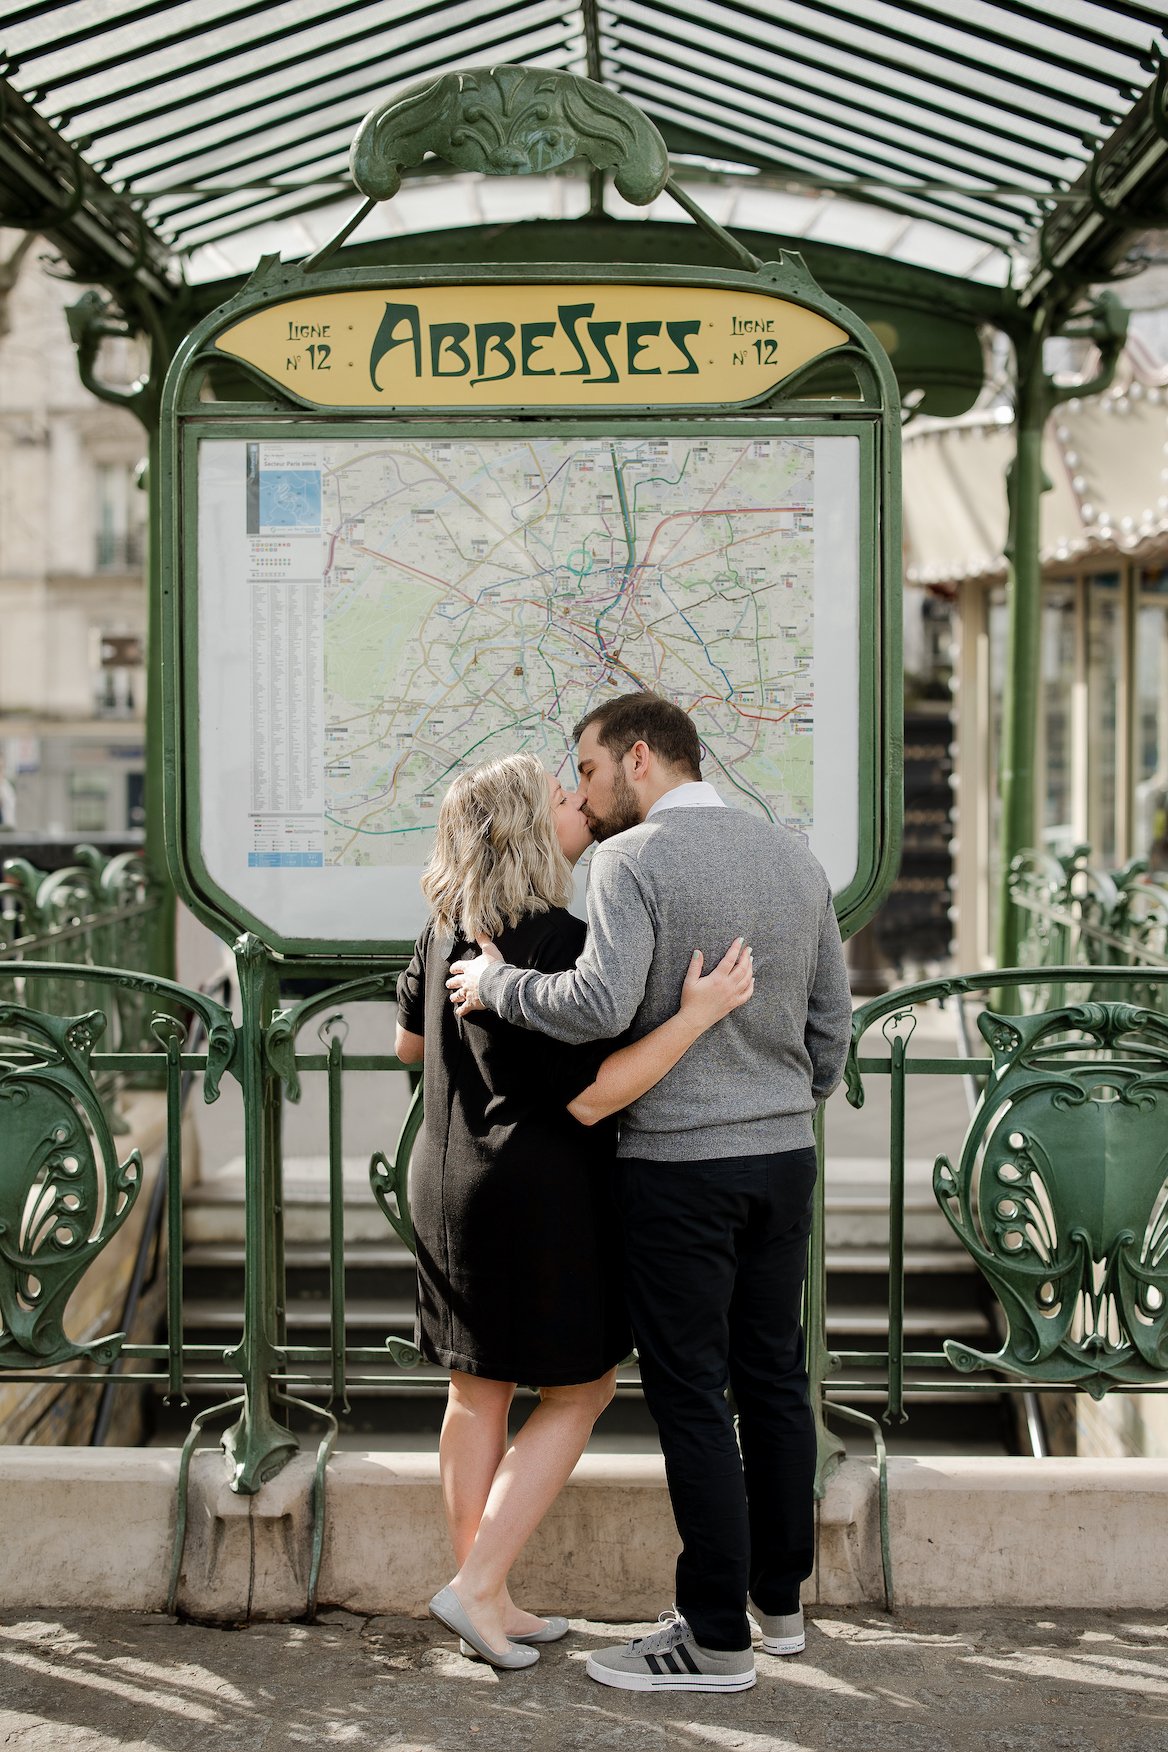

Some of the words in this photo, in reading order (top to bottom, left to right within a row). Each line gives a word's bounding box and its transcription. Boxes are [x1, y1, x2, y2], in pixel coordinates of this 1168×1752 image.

[286, 321, 331, 341] LIGNE
[729, 316, 775, 336] LIGNE
[305, 344, 331, 370] 12
[369, 302, 701, 392] ABBESSES
[752, 339, 778, 365] 12
